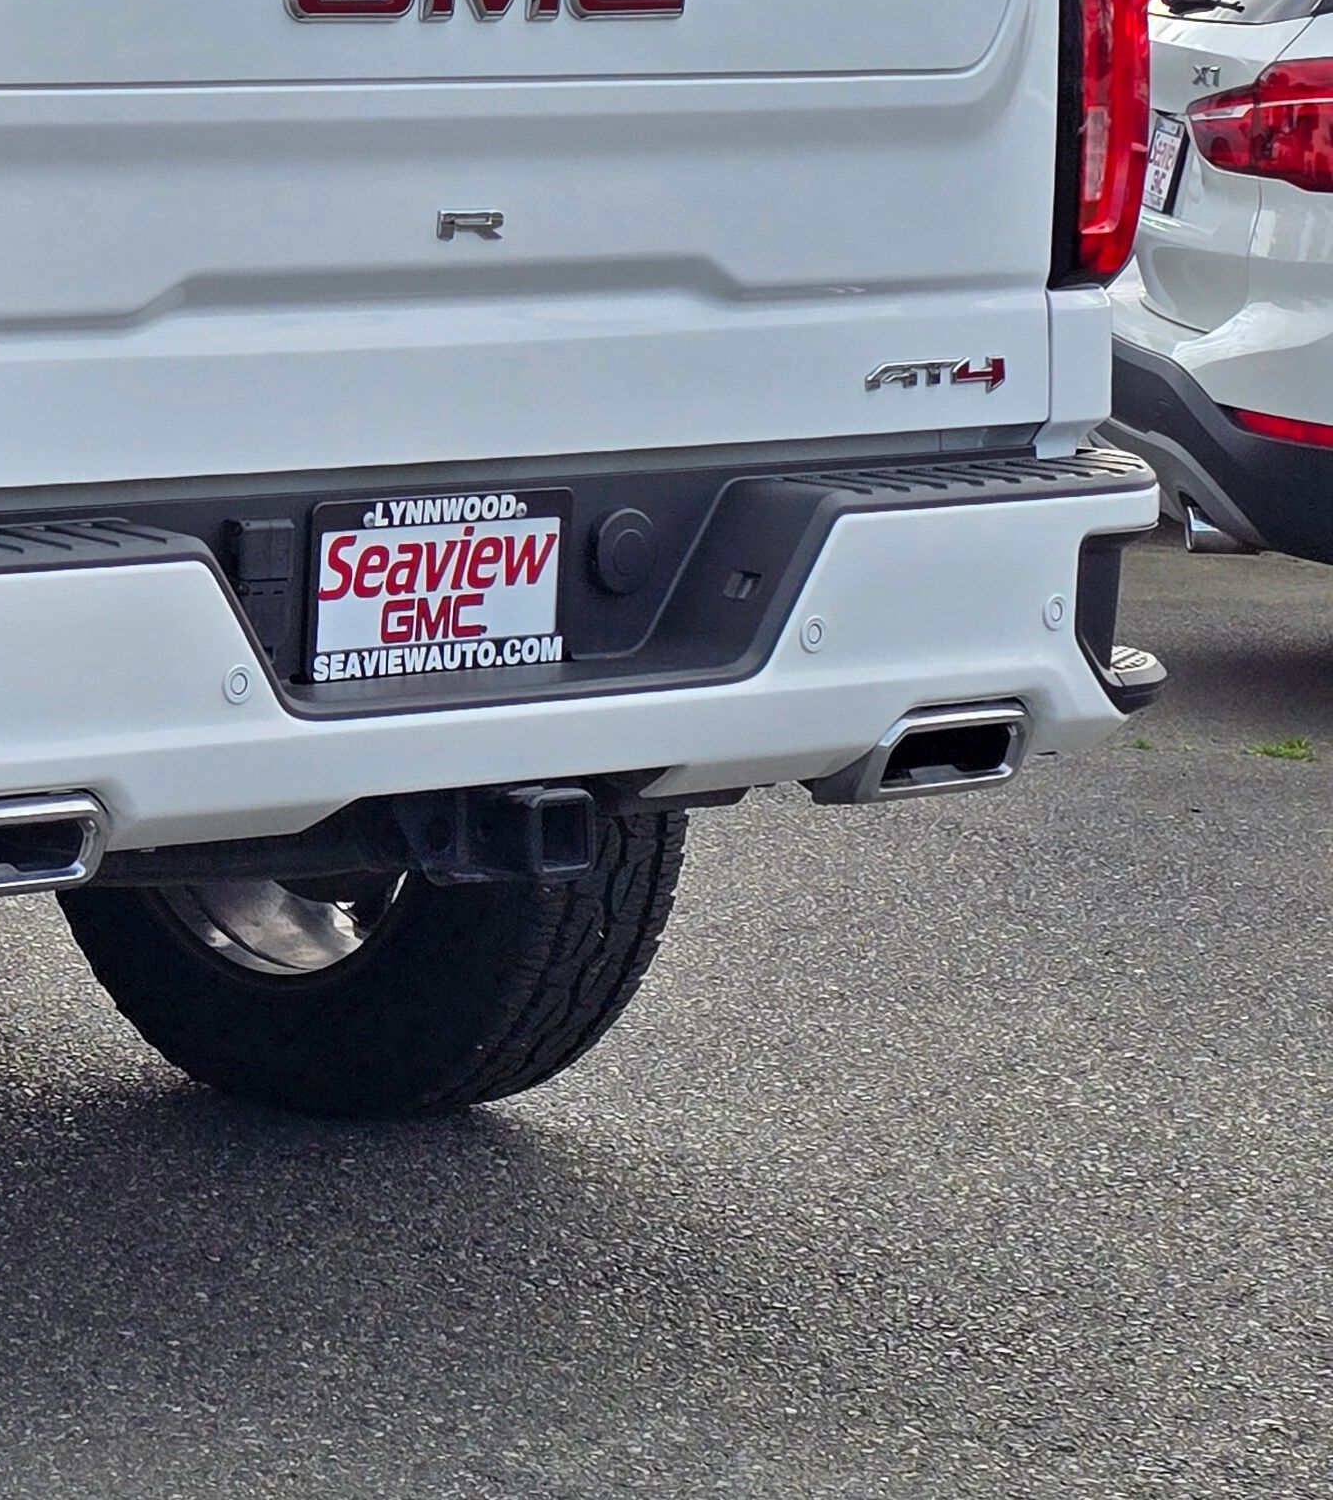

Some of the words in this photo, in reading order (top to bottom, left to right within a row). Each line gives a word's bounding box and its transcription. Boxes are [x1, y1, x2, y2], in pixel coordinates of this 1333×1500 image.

[1192, 65, 1221, 88] X1
[437, 208, 505, 240] R
[865, 356, 1005, 394] AT4
[374, 494, 517, 527] LYNNWOOD
[318, 526, 557, 601] Seaview
[380, 594, 487, 644] GMC
[313, 636, 563, 683] SEAVIEWAUTO.COM
